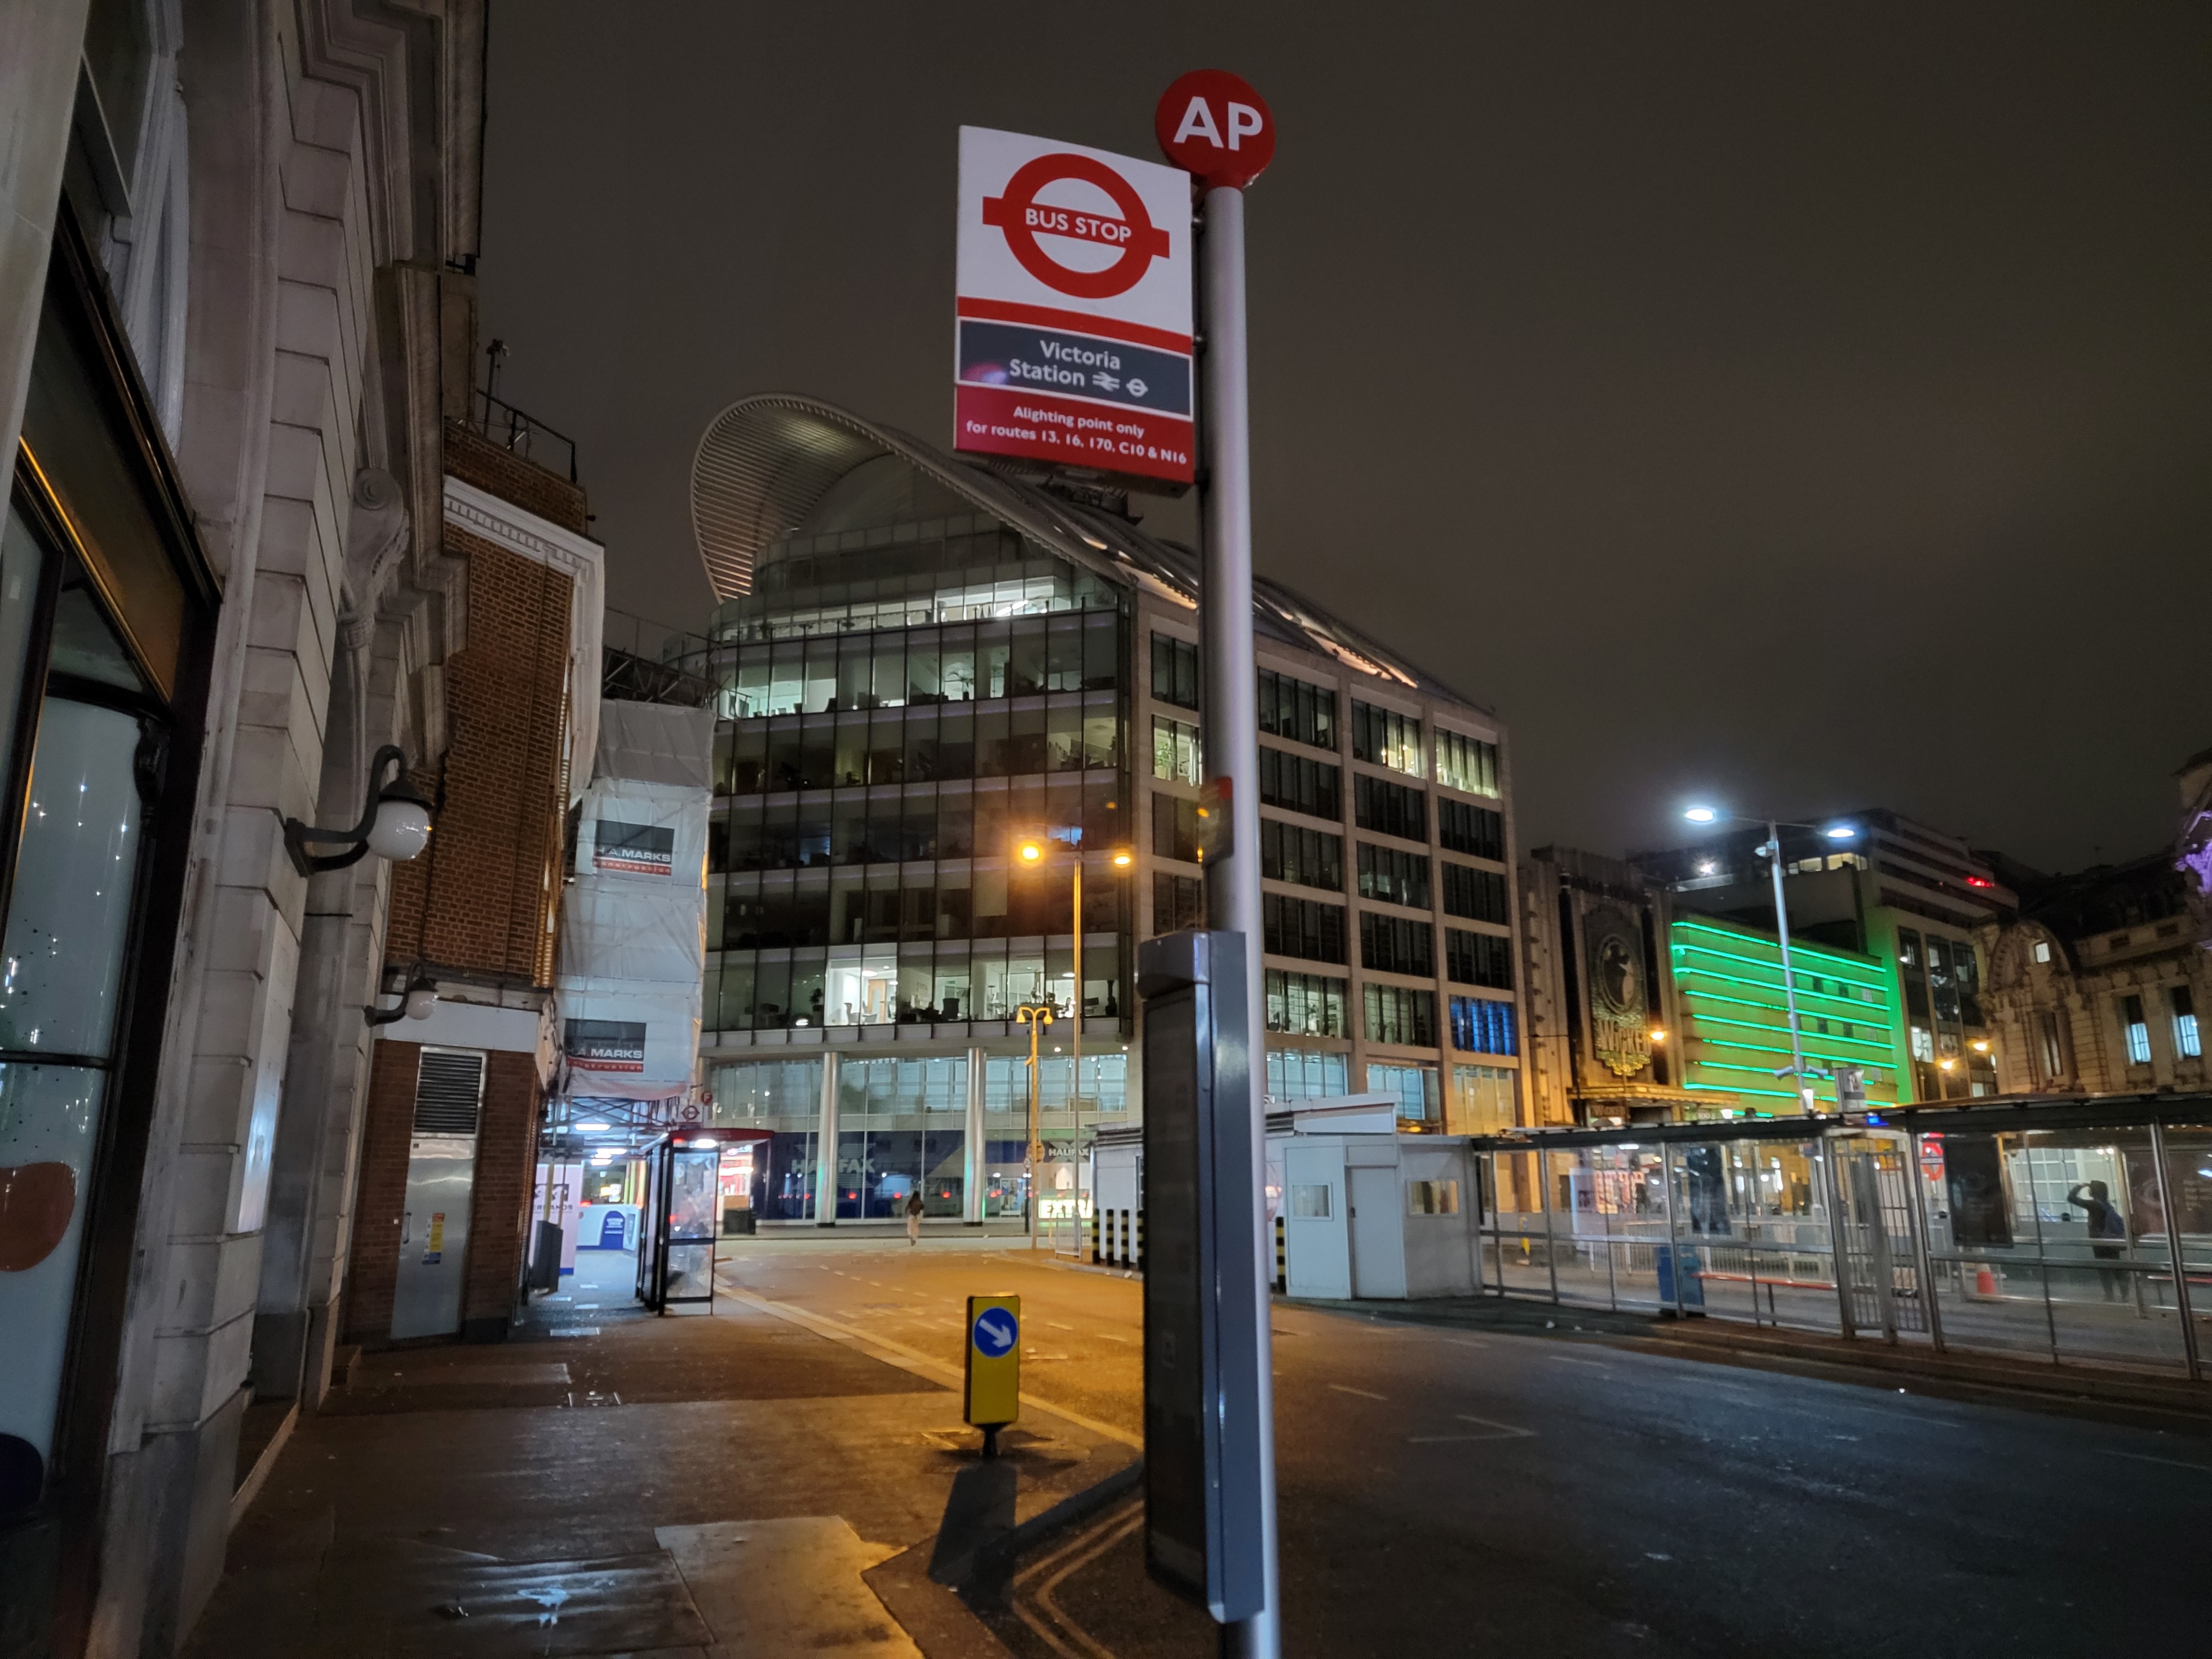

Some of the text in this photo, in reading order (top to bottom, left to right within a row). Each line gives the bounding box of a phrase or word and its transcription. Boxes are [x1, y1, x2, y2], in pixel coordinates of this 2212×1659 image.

[1173, 96, 1263, 151] AP
[1026, 208, 1131, 242] BUS STOP
[1040, 340, 1120, 371] Victoria
[1009, 358, 1085, 387] Station
[1013, 406, 1145, 439] Alighting point only
[967, 420, 988, 434] for
[991, 425, 1037, 440] routes
[1119, 441, 1145, 457] C10
[1147, 446, 1157, 460] &
[1161, 448, 1187, 465] N16
[704, 1094, 710, 1102] F
[791, 1159, 875, 1173] HAFAX
[1048, 1148, 1089, 1156] HALIFAX
